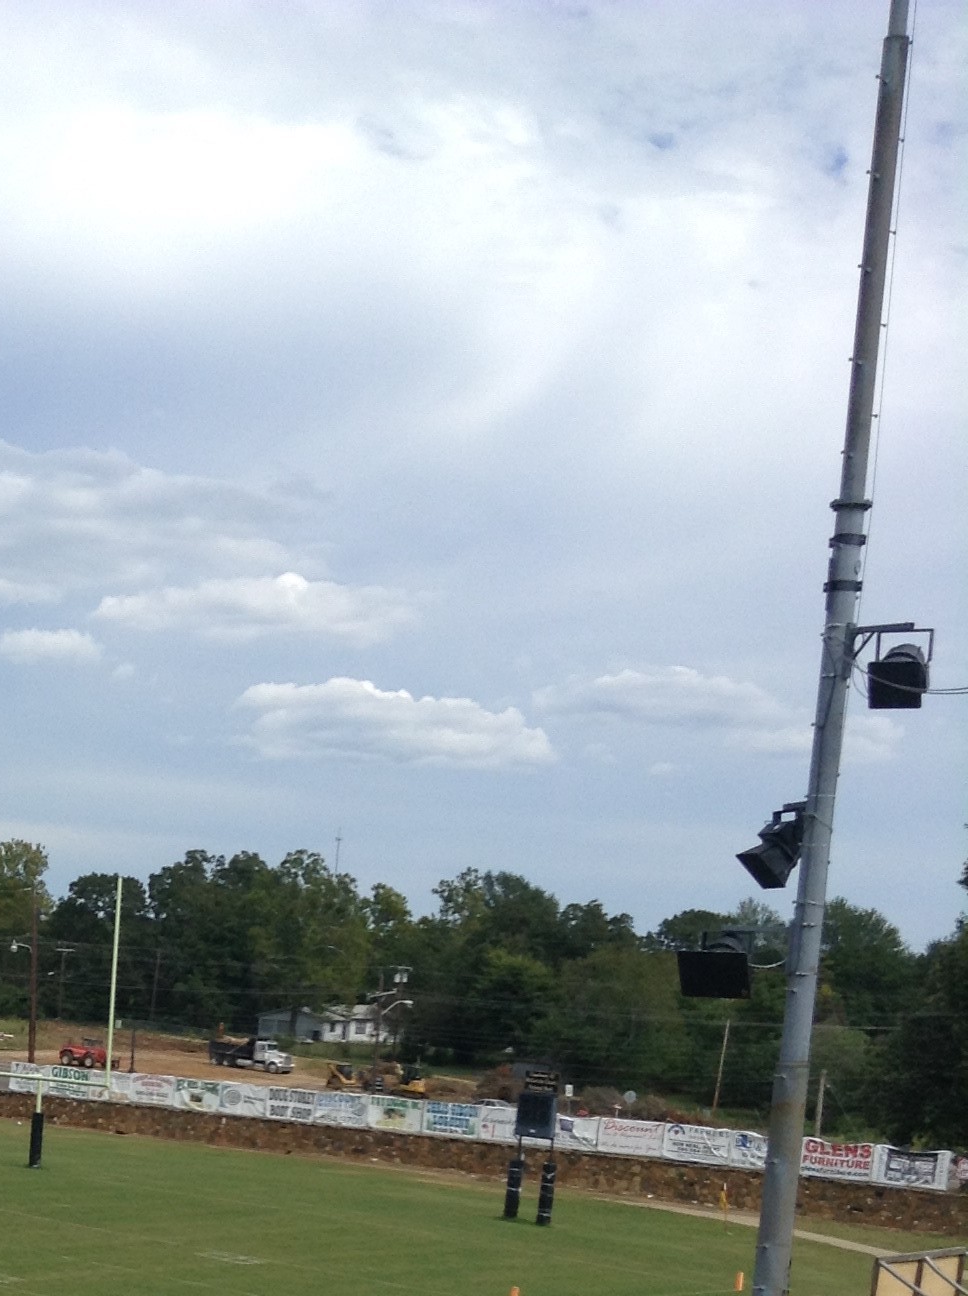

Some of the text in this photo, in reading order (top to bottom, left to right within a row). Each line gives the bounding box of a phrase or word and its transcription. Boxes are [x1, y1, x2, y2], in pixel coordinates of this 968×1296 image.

[51, 1066, 90, 1081] GIBSON
[290, 1106, 312, 1120] SHOP
[805, 1139, 872, 1159] GLENS
[802, 1154, 871, 1171] FURNITURE
